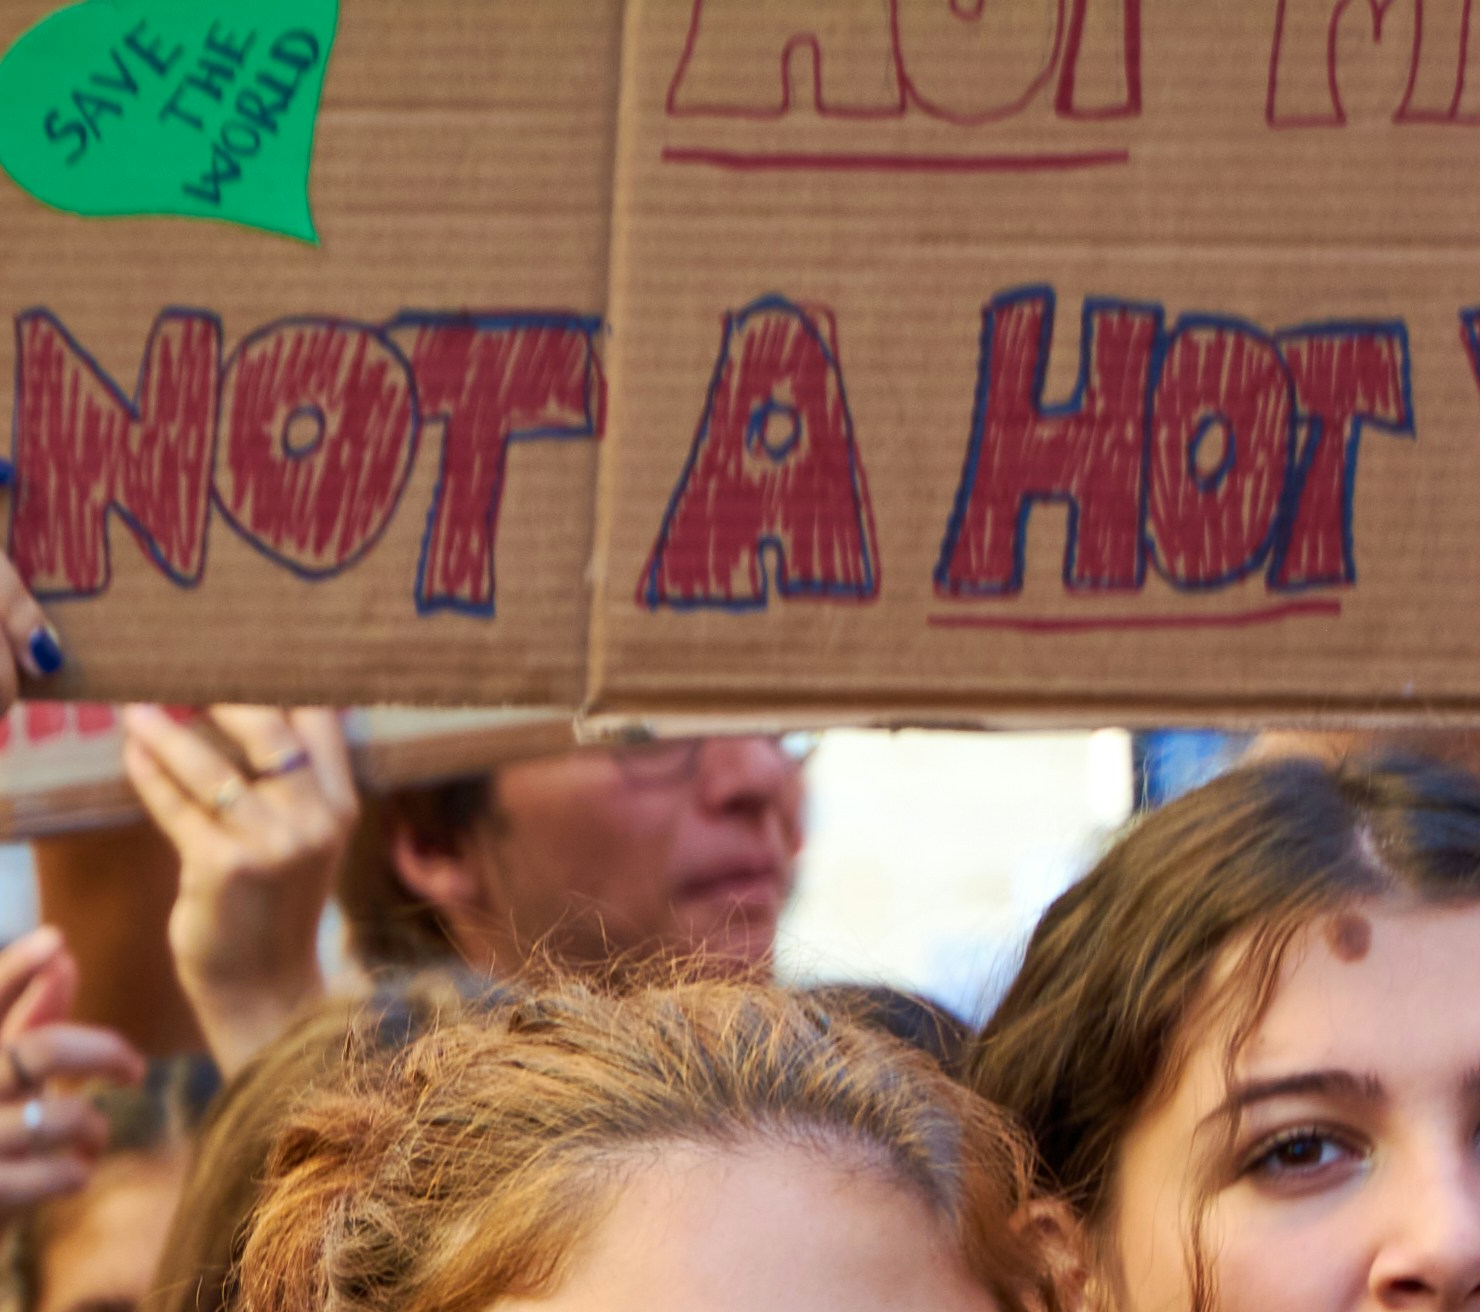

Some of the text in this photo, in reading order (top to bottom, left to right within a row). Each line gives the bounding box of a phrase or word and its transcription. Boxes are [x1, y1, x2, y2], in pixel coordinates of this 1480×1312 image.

[43, 18, 185, 167] SAVE
[159, 18, 257, 131] THE
[182, 27, 320, 205] WORLD
[11, 305, 608, 618] NOT
[636, 293, 880, 613] A
[934, 284, 1417, 598] HOT
